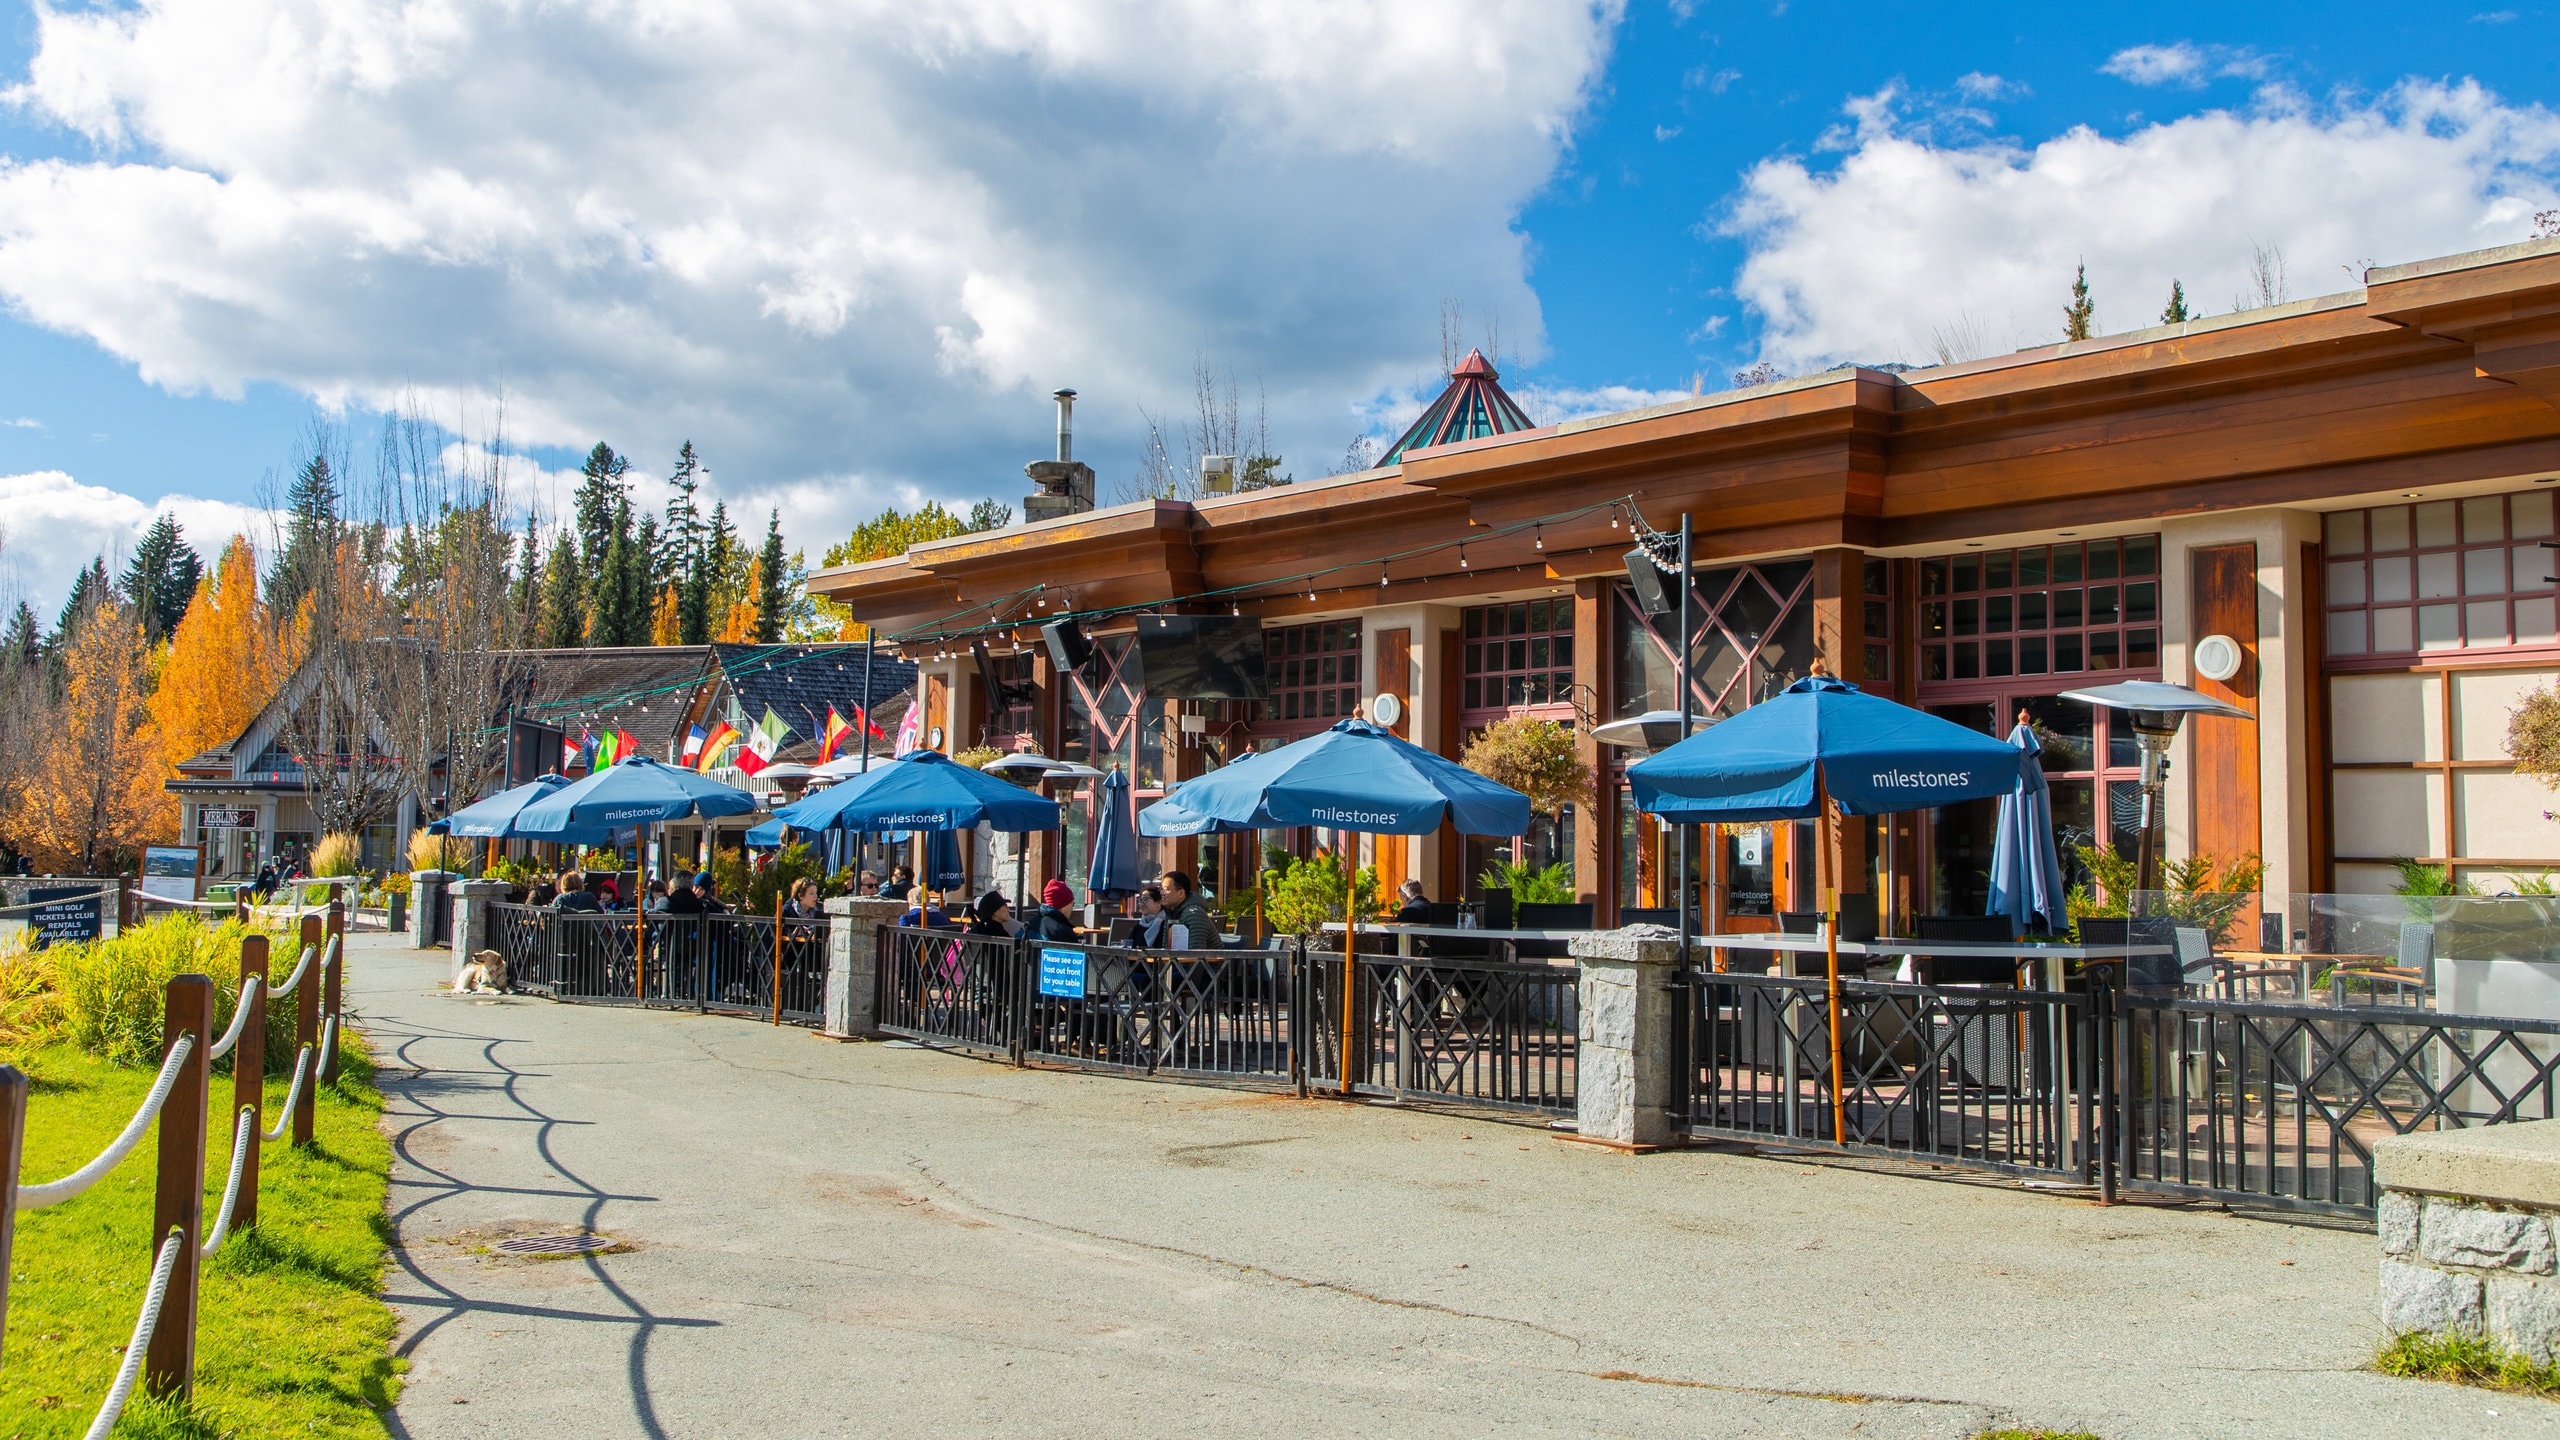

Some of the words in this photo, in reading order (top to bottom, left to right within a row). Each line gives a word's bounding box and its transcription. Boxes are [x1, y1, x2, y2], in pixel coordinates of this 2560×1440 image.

[1872, 768, 1970, 788] milestones
[605, 807, 661, 820] milestones
[878, 811, 946, 824] milestones
[1312, 806, 1399, 825] milestones
[1159, 820, 1200, 832] milestones
[1730, 890, 1771, 900] milestones
[64, 903, 85, 912] GOLF
[34, 913, 66, 921] TICKETS
[47, 921, 81, 929] RENTALS
[39, 929, 79, 939] AVAILABLE
[80, 929, 90, 937] AT
[1043, 953, 1060, 964] Please
[1060, 957, 1071, 965] see
[1044, 964, 1056, 974] host
[1066, 966, 1081, 976] front
[1043, 975, 1051, 984] for
[1051, 978, 1064, 987] your
[1065, 978, 1081, 988] table
